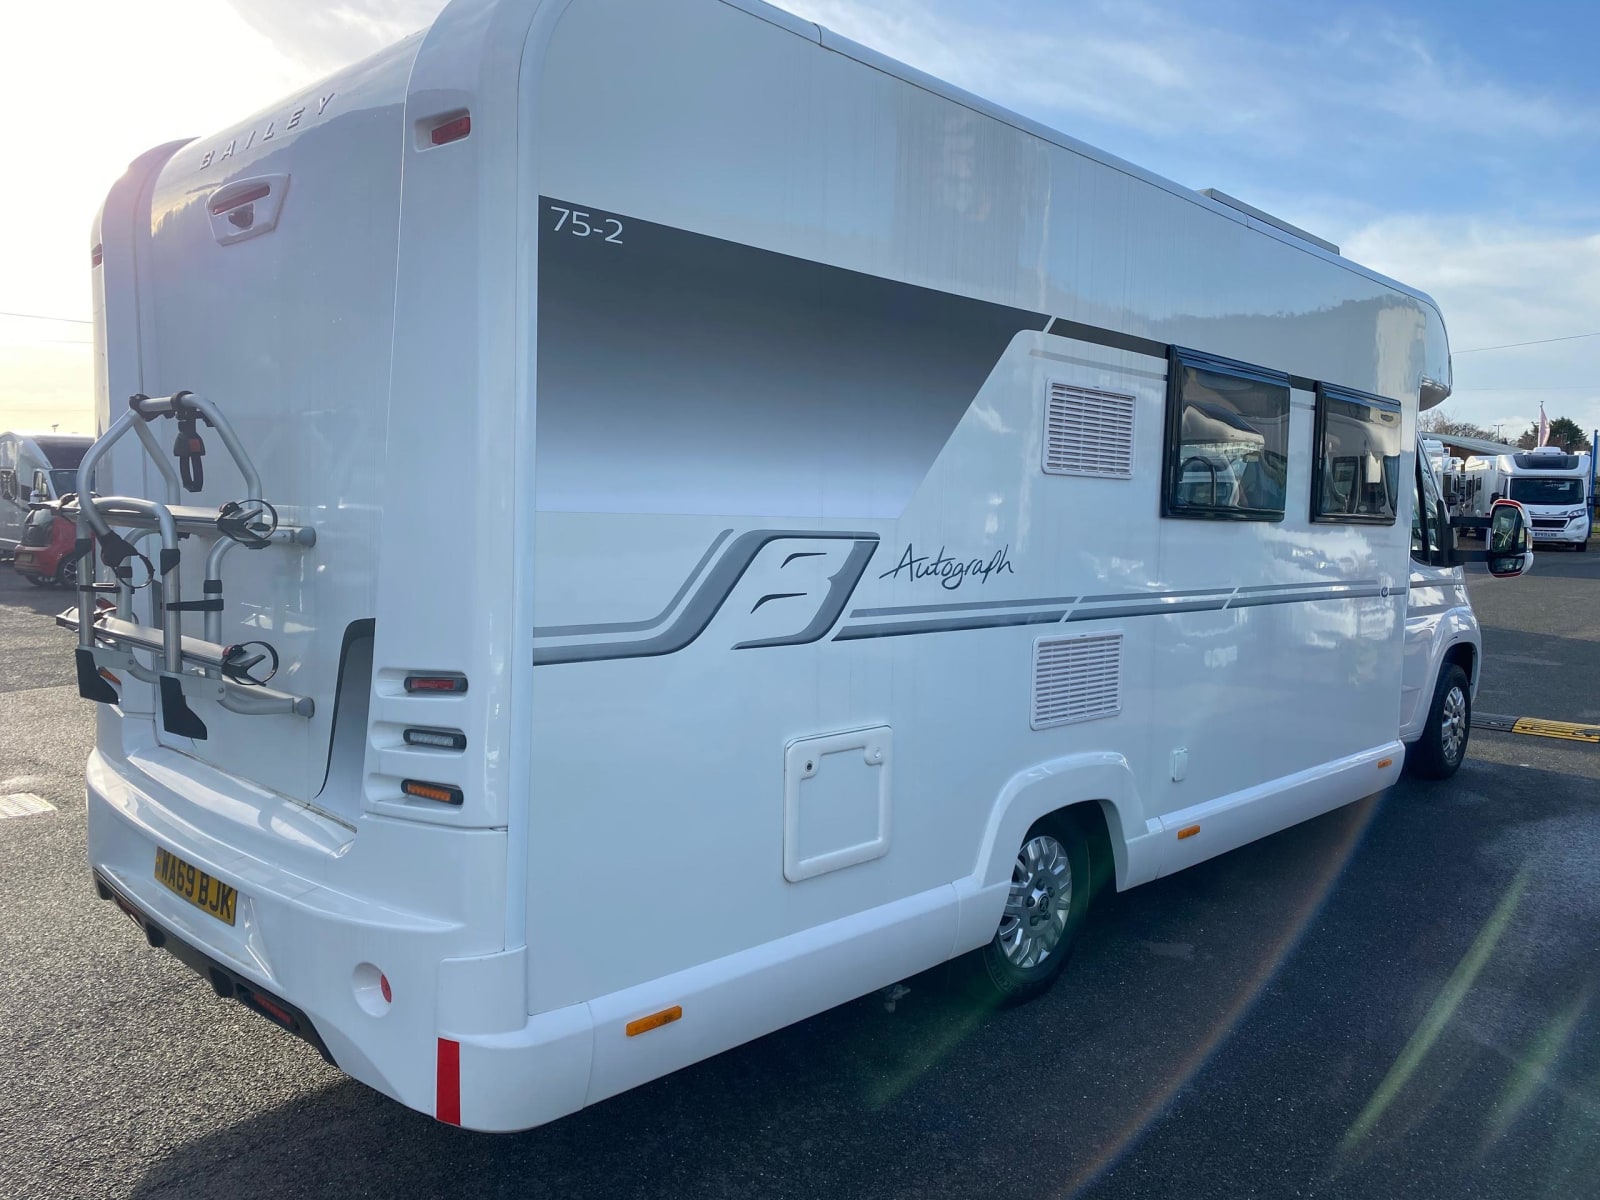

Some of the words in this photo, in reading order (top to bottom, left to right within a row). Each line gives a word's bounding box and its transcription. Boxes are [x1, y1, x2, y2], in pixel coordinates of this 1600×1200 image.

[199, 92, 335, 170] BAILEY
[550, 205, 624, 245] 75-2
[878, 542, 1014, 590] Autograph
[161, 849, 196, 898] WA69
[197, 871, 233, 919] BJK
